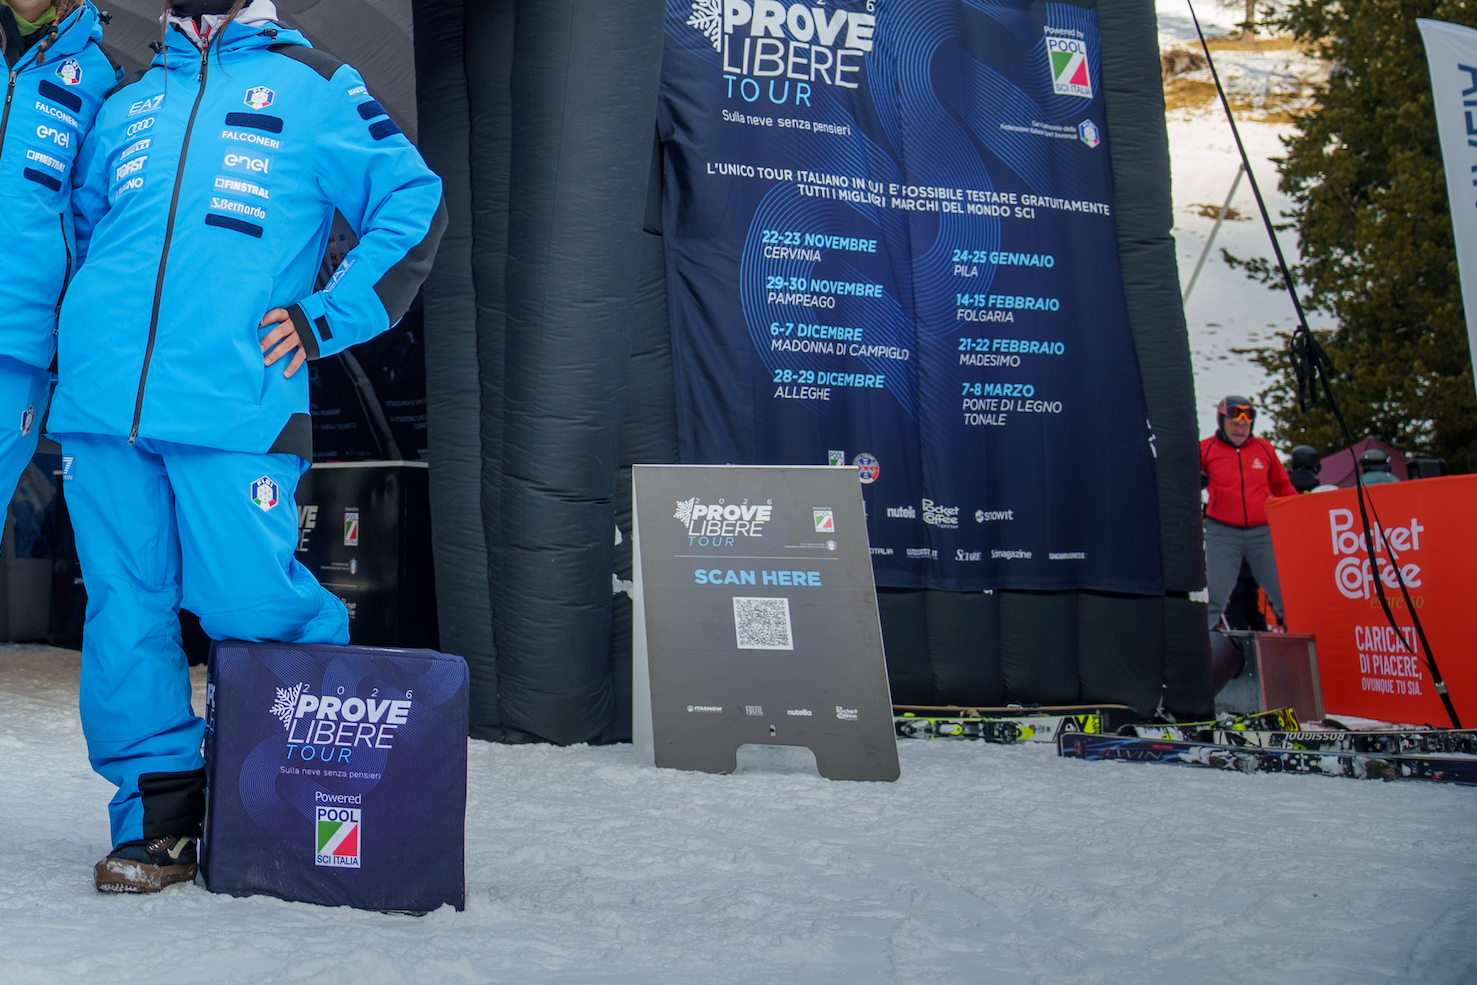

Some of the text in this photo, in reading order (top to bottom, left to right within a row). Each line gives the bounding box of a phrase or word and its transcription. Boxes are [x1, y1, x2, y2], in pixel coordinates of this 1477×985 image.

[1049, 40, 1084, 54] POOL
[722, 38, 864, 89] LIBERE
[723, 75, 812, 107] TOUR
[1056, 83, 1090, 95] SCI ITALIA
[129, 93, 165, 114] EA7
[35, 101, 79, 128] FALCONERI
[722, 109, 851, 137] Sulla neve senza pensieri
[36, 125, 69, 148] enel
[221, 129, 280, 149] FALCONERI
[223, 153, 269, 175] enel
[224, 179, 270, 199] FINSTRAL
[707, 162, 1110, 216] L'UNICO TOUR ITALIANO IN TESTARE GRATUITAMENTE
[210, 197, 266, 220] S.Bernardo
[798, 184, 1035, 219] TUTTI I MARCHI DEL MONDO SCI
[761, 229, 877, 253] 22-23 NOVEMBRE
[763, 246, 822, 263] CERVINIA
[952, 249, 1054, 268] 24-25 GENNAIO
[953, 265, 978, 278] PILA
[766, 275, 884, 298] 29-30 NOVEMBRE
[767, 292, 836, 309] PAMPEAGO
[955, 293, 1060, 311] 14-15 FEBBRAIO
[956, 309, 1014, 323] FOLGARIA
[770, 322, 863, 341] 6-7 DICEMBRE
[771, 338, 847, 355] MADONNA DI
[958, 338, 1065, 355] 21-22 FEBBRAIO
[959, 354, 1021, 368] MADESIMO
[773, 369, 885, 389] 28-29 DICEMBRE
[774, 386, 831, 401] ALLEGHE
[962, 383, 1035, 398] 7-8 MARZO
[962, 399, 1062, 414] PONTE DI LEGNO
[963, 413, 1006, 426] TONALE
[829, 451, 844, 460] POOL
[691, 504, 772, 521] PROVE
[688, 520, 765, 537] LIBERE
[1329, 508, 1424, 559] Pocket
[688, 536, 735, 547] TOUR
[694, 569, 822, 587] SCAN HERE
[1335, 557, 1422, 600] Coffee
[1355, 625, 1418, 653] CARICATI
[1359, 653, 1423, 680] DI PIACERE,
[1361, 676, 1422, 696] OVUNQUE TU SIA.
[295, 694, 412, 724] PROVE
[287, 719, 398, 749] LIBERE
[286, 744, 352, 763] TOUR
[280, 766, 381, 780] Sulla neve senza pensieri
[315, 791, 362, 804] Powered
[317, 809, 359, 823] POOL
[316, 854, 359, 866] SCI ITALIA
